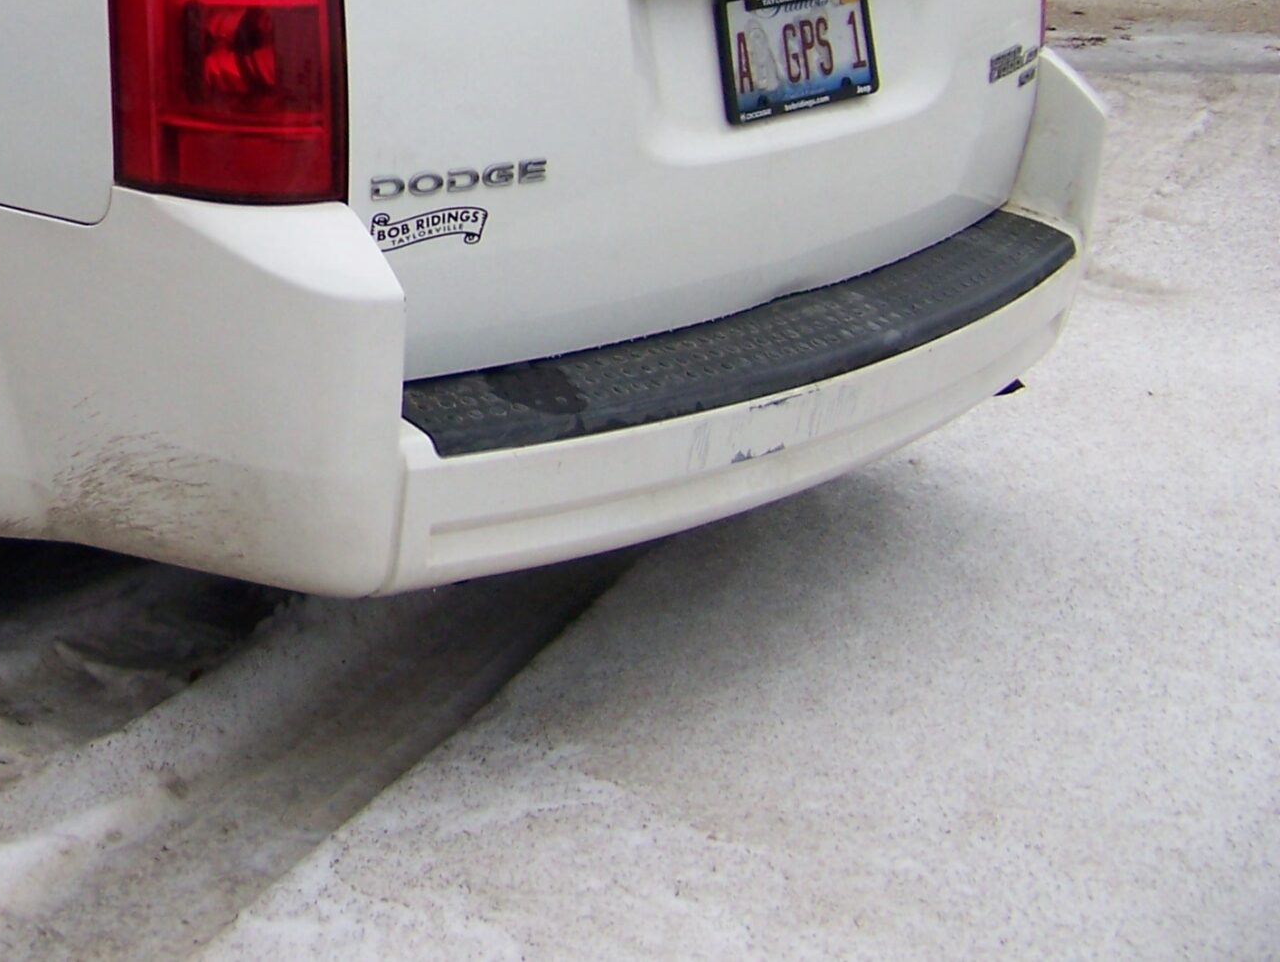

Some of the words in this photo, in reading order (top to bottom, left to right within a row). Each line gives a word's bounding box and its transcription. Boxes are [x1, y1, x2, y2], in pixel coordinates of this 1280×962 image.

[737, 31, 754, 94] A
[782, 17, 834, 84] GPS
[847, 10, 867, 69] 1
[370, 158, 547, 201] DODGE
[376, 223, 410, 242] BOB
[416, 210, 480, 232] RIDINGS
[391, 223, 464, 248] TAYLORVILLE
